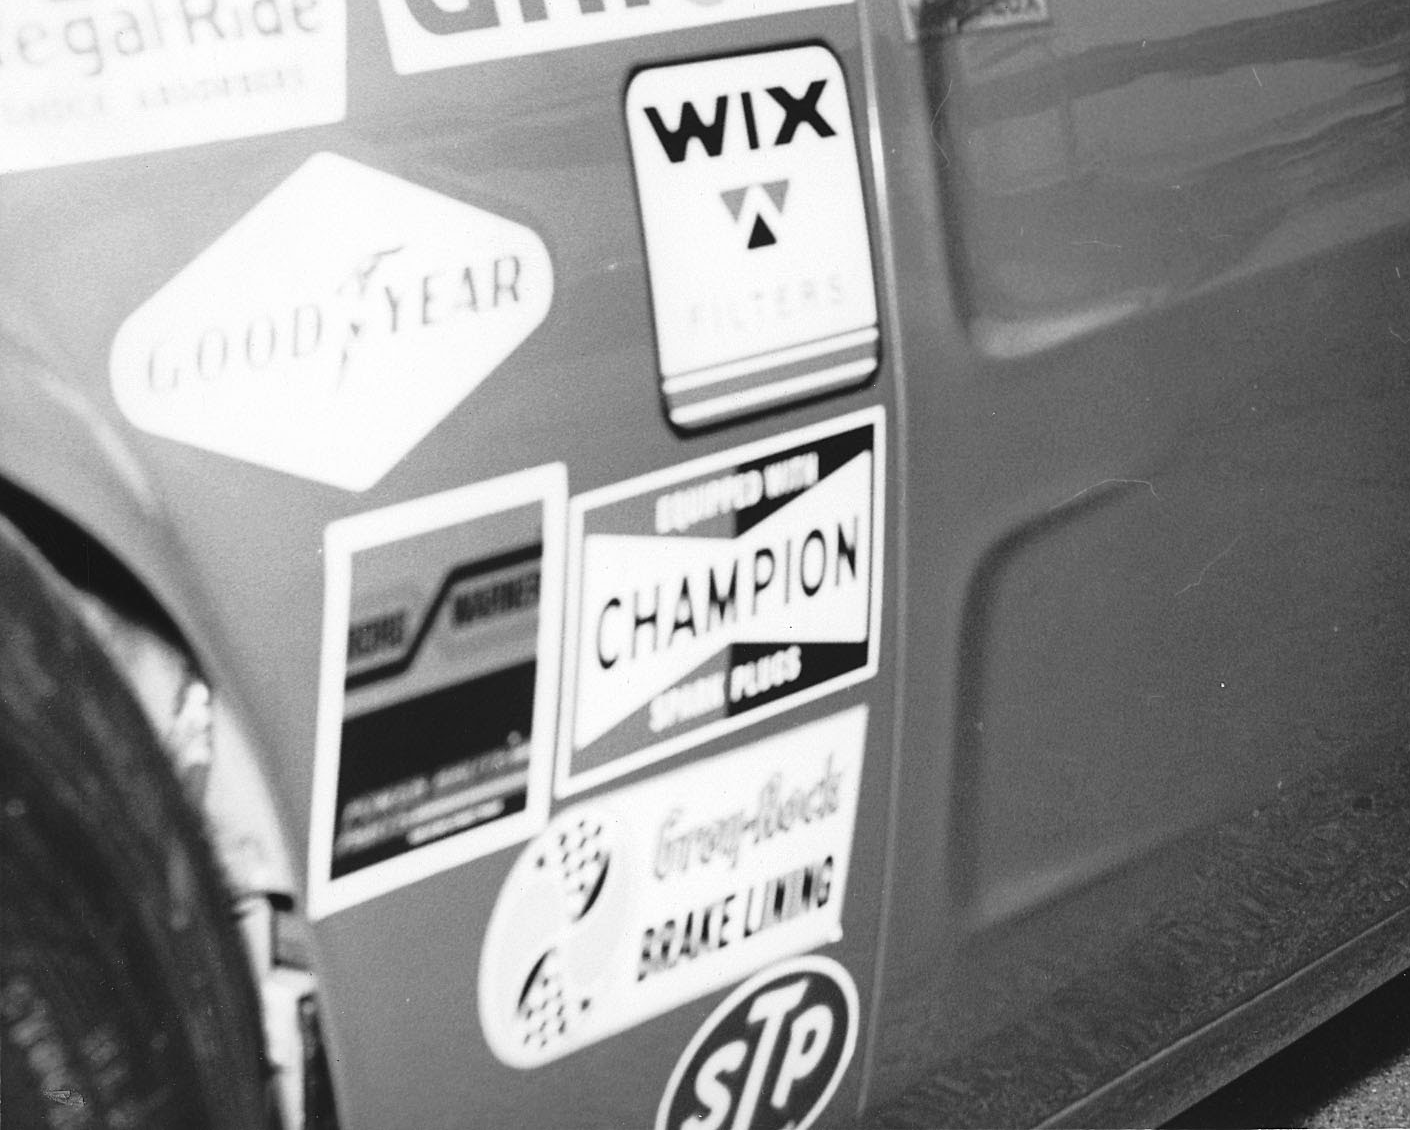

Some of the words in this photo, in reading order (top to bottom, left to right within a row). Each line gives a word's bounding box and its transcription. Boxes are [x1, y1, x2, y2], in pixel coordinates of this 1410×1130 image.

[643, 79, 838, 162] WIX
[599, 515, 860, 670] CHAMPION
[637, 894, 736, 983] BRAKE
[743, 855, 835, 939] LINING
[680, 977, 834, 1130] STP
